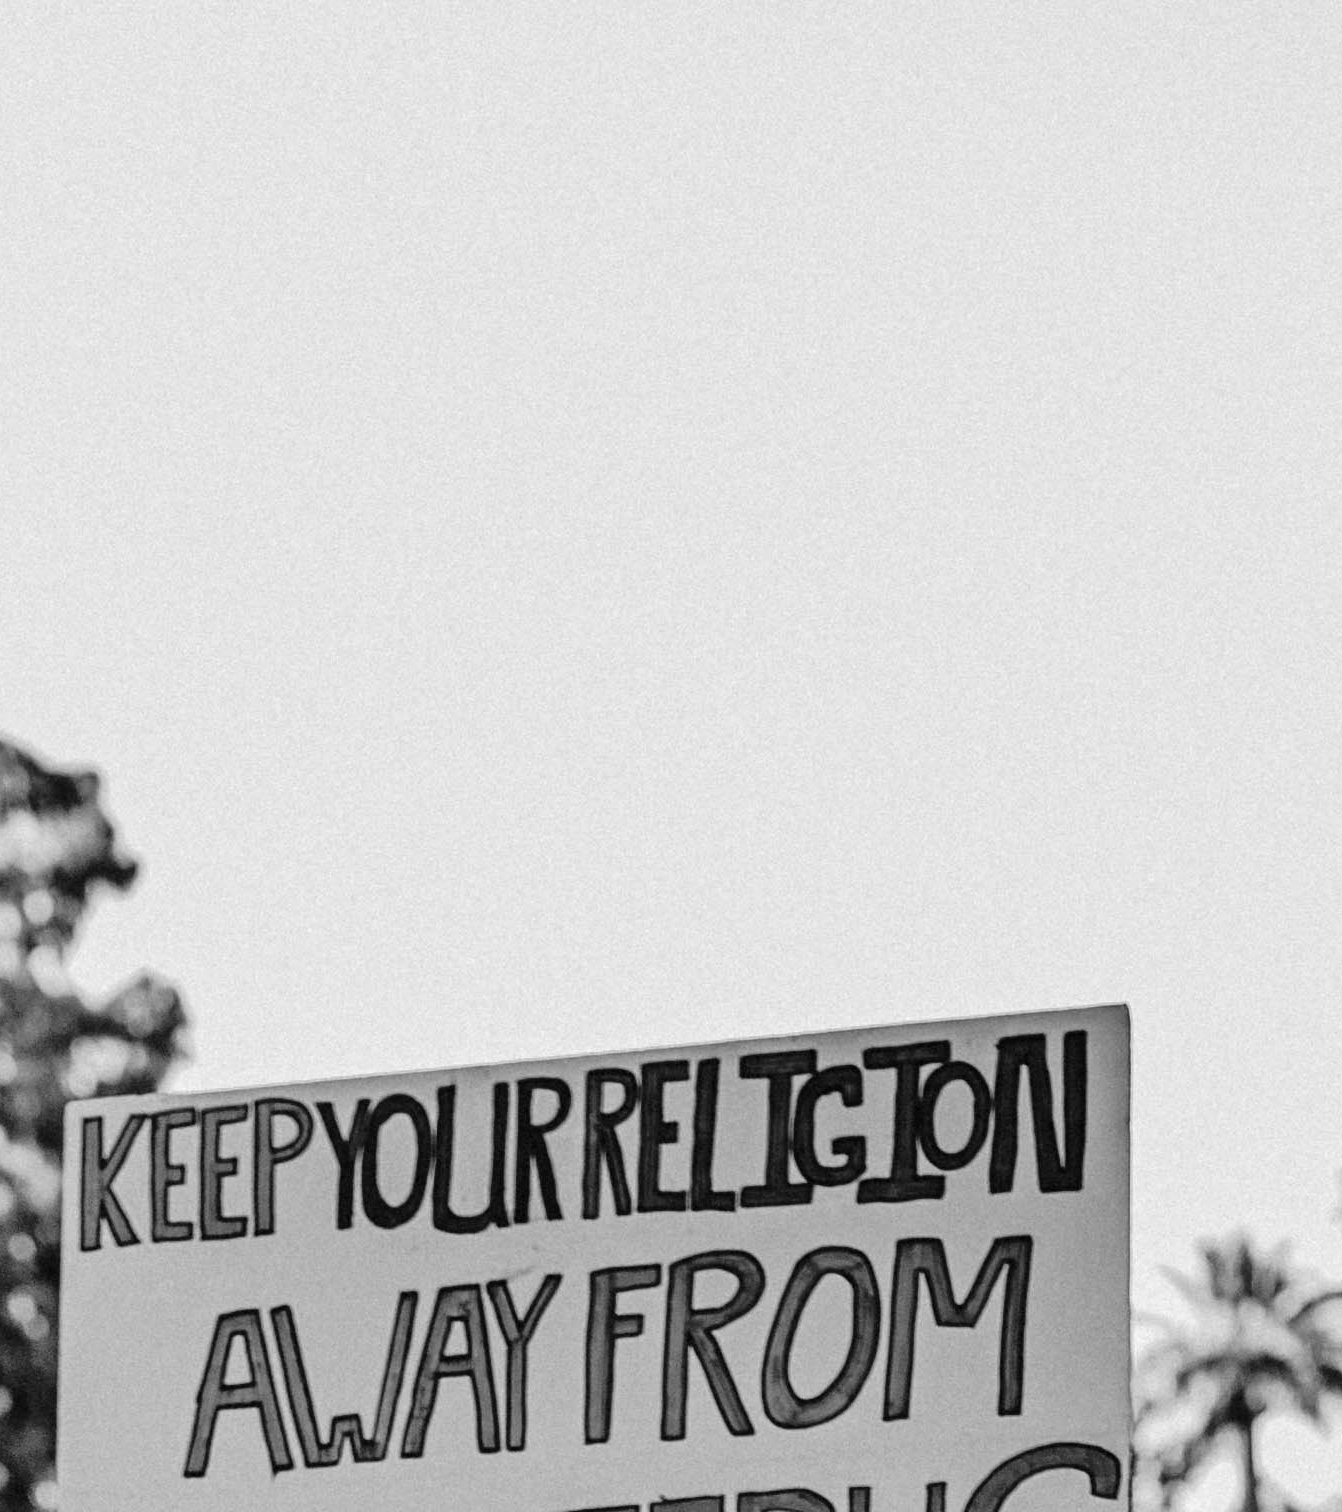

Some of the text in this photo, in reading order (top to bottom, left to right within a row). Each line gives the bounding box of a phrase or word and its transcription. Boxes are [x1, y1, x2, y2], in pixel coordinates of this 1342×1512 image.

[80, 1029, 1088, 1251] KEEP YOUR RELIGION
[184, 1235, 1033, 1477] AWAY FROM
